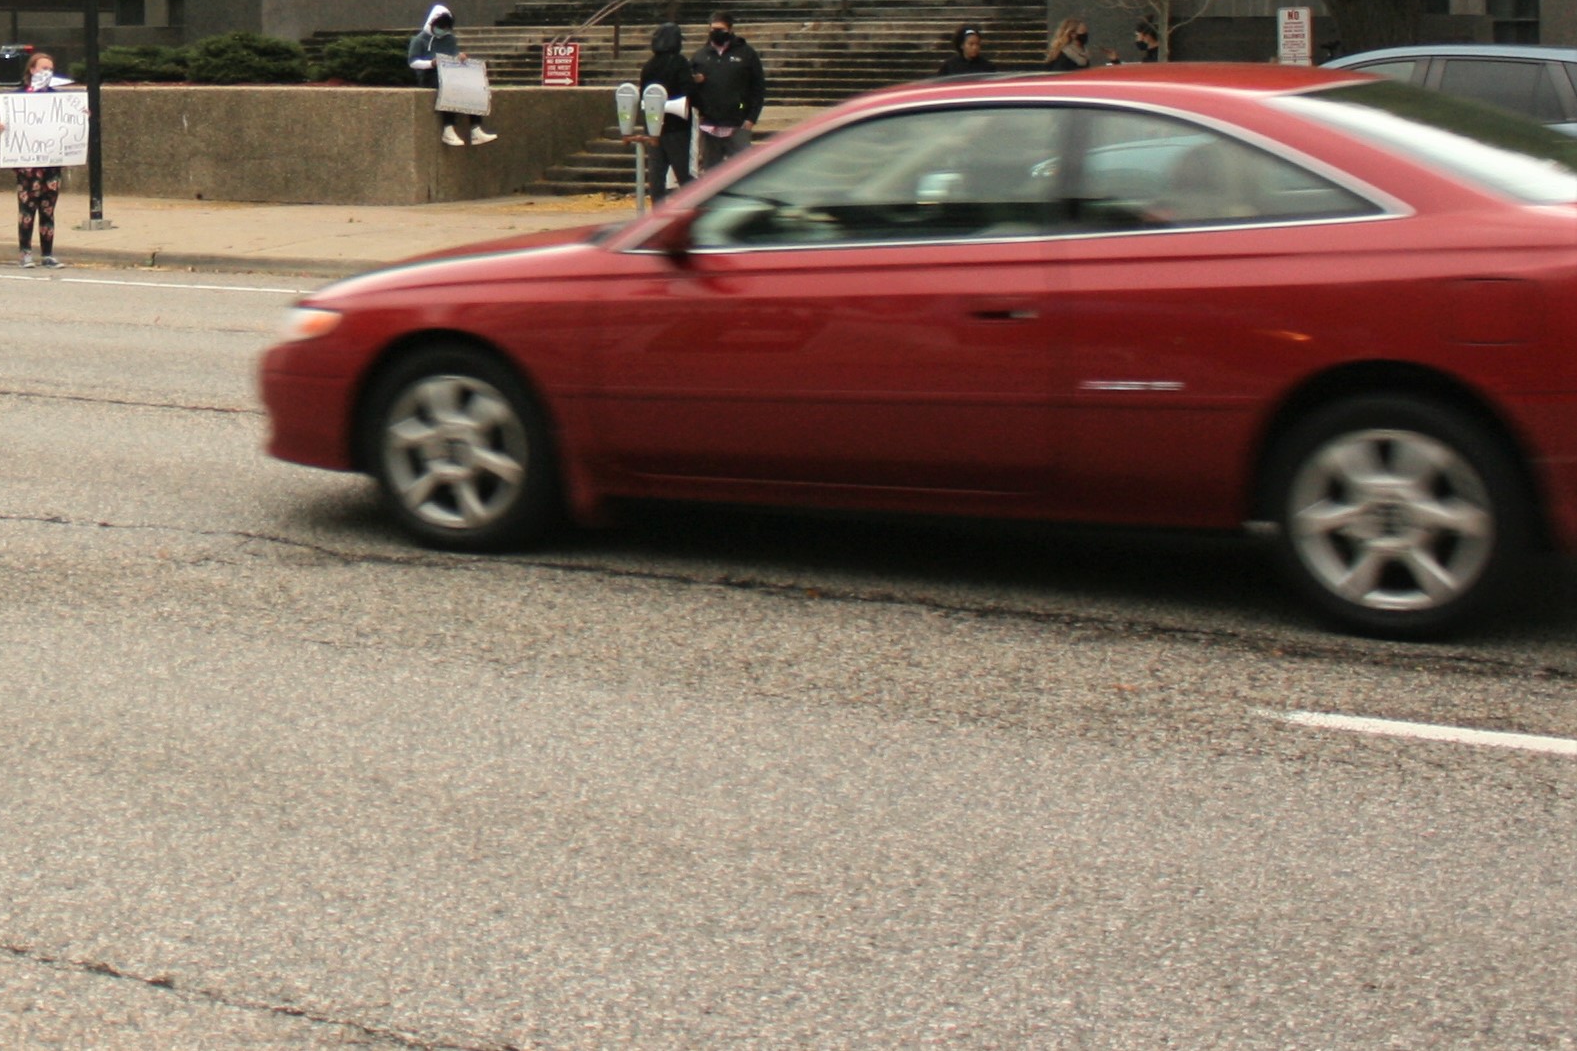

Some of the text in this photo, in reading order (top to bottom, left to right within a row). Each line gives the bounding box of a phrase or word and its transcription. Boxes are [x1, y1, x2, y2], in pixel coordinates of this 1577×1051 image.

[546, 46, 574, 56] STOP
[11, 97, 45, 126] How
[49, 96, 86, 142] Many
